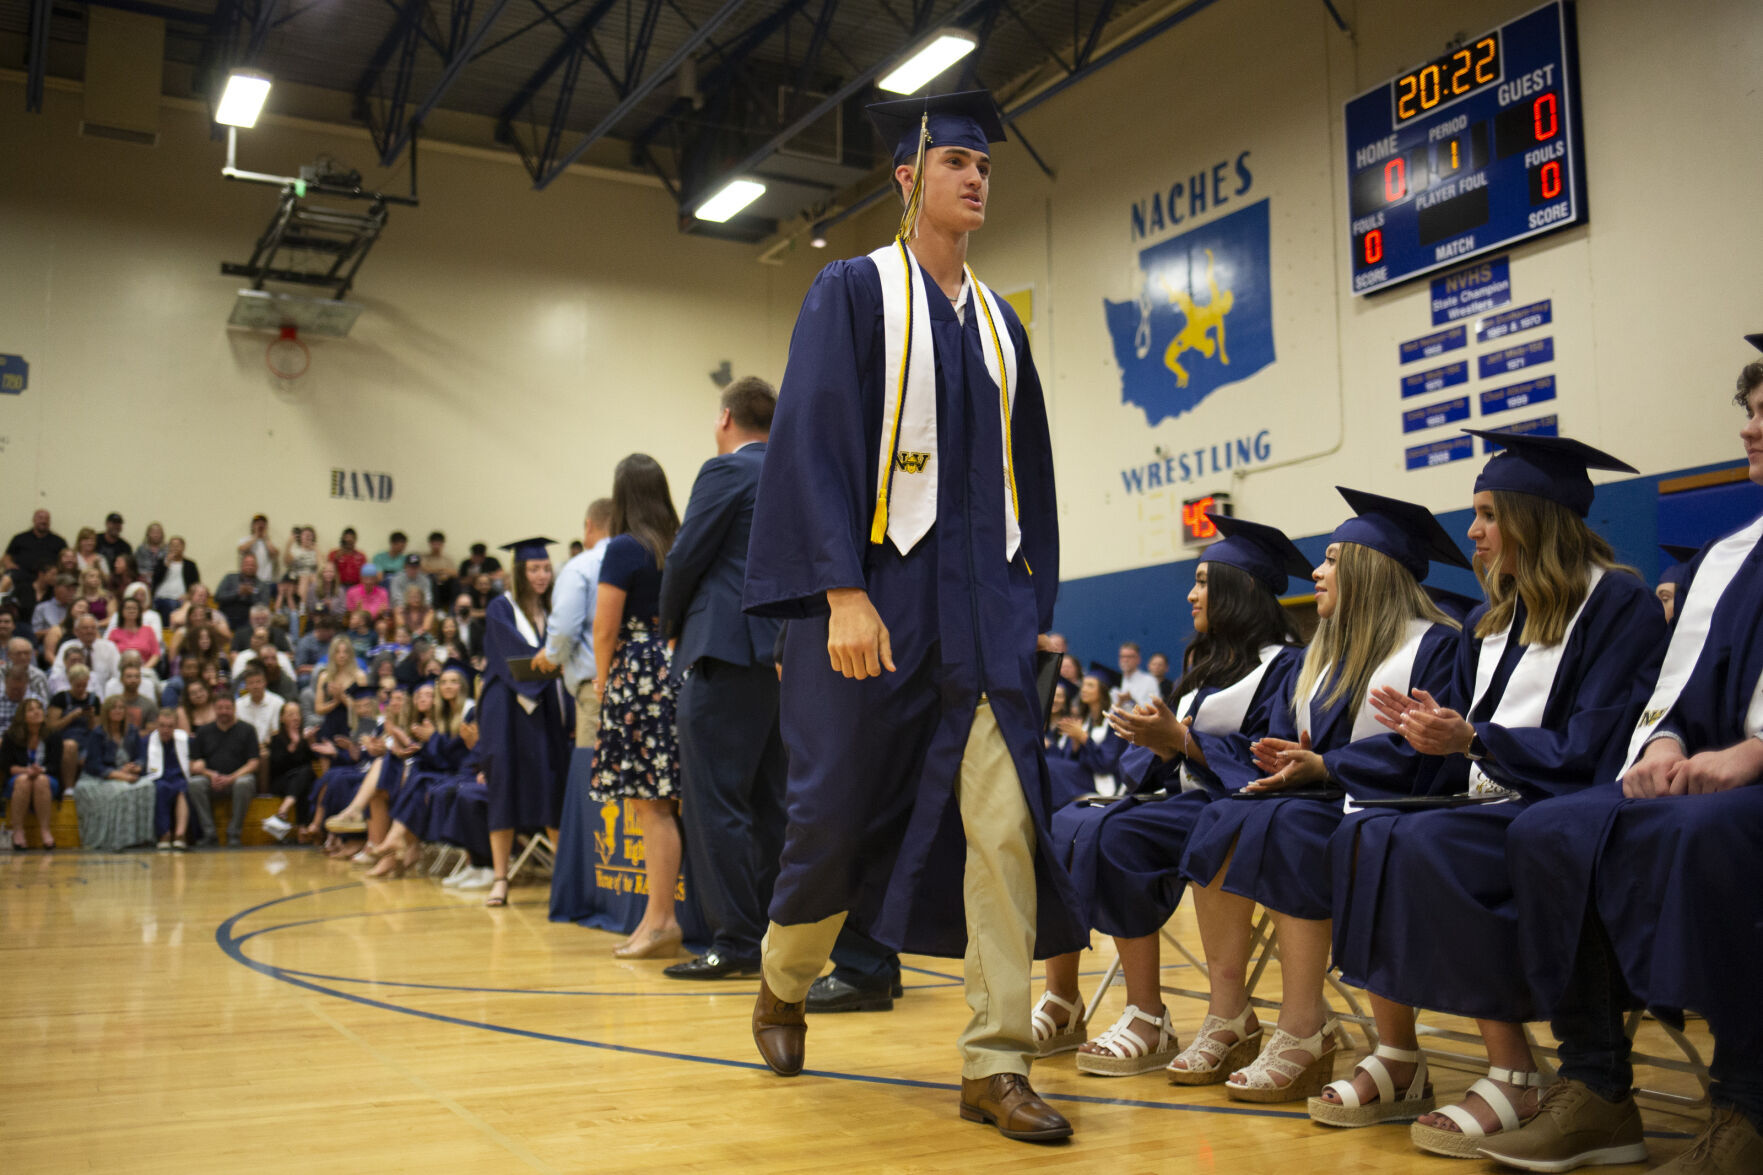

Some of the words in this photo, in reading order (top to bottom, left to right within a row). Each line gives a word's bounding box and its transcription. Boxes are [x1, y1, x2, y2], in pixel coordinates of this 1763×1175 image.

[1398, 37, 1495, 120] 20:22
[1498, 64, 1555, 106] GUEST
[1428, 114, 1467, 143] PERIOD
[1533, 93, 1558, 141] 0
[1356, 134, 1398, 169] HOME
[1451, 140, 1459, 169] 1
[1525, 141, 1564, 169] FOULS
[1131, 150, 1253, 243] NACHES
[1384, 157, 1406, 202] 0
[1416, 181, 1457, 211] PLAYER
[1459, 172, 1488, 192] FOUL
[1541, 161, 1561, 199] 0
[1353, 212, 1385, 235] FOULS
[1528, 202, 1569, 229] SCORE
[1364, 229, 1383, 264] 0
[1435, 236, 1475, 262] MATCH
[1354, 268, 1388, 290] SCORE
[1445, 264, 1493, 293] NVHS
[1460, 280, 1509, 303] Champion
[1121, 430, 1271, 495] WRESTLING
[330, 468, 393, 502] BAND
